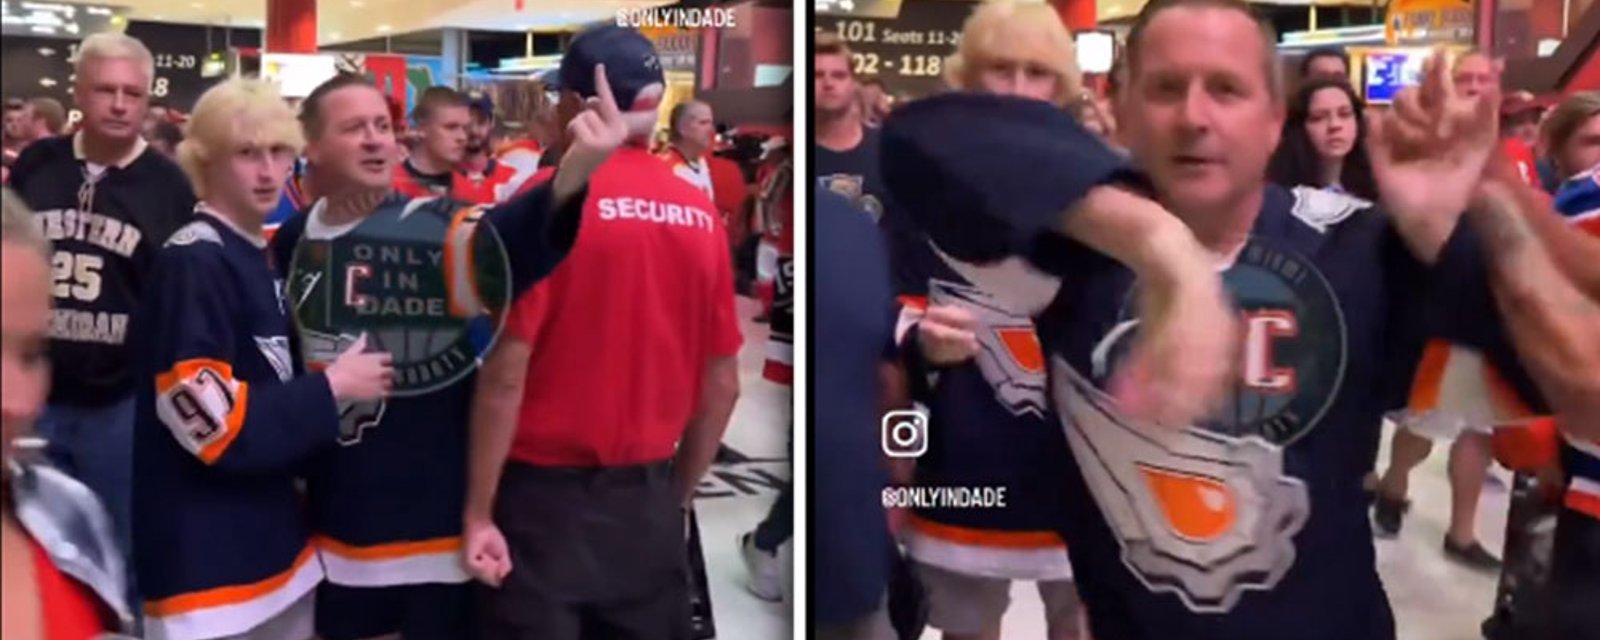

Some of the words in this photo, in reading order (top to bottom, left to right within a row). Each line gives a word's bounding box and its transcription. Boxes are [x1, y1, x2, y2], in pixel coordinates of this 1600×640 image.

[836, 20, 877, 42] 101
[882, 28, 924, 44] Seats
[926, 30, 963, 45] 11-2
[852, 52, 880, 75] 02
[899, 54, 942, 76] 118
[597, 197, 714, 233] SECURITY
[51, 250, 104, 302] 25
[1243, 308, 1297, 395] C
[170, 367, 235, 442] 97
